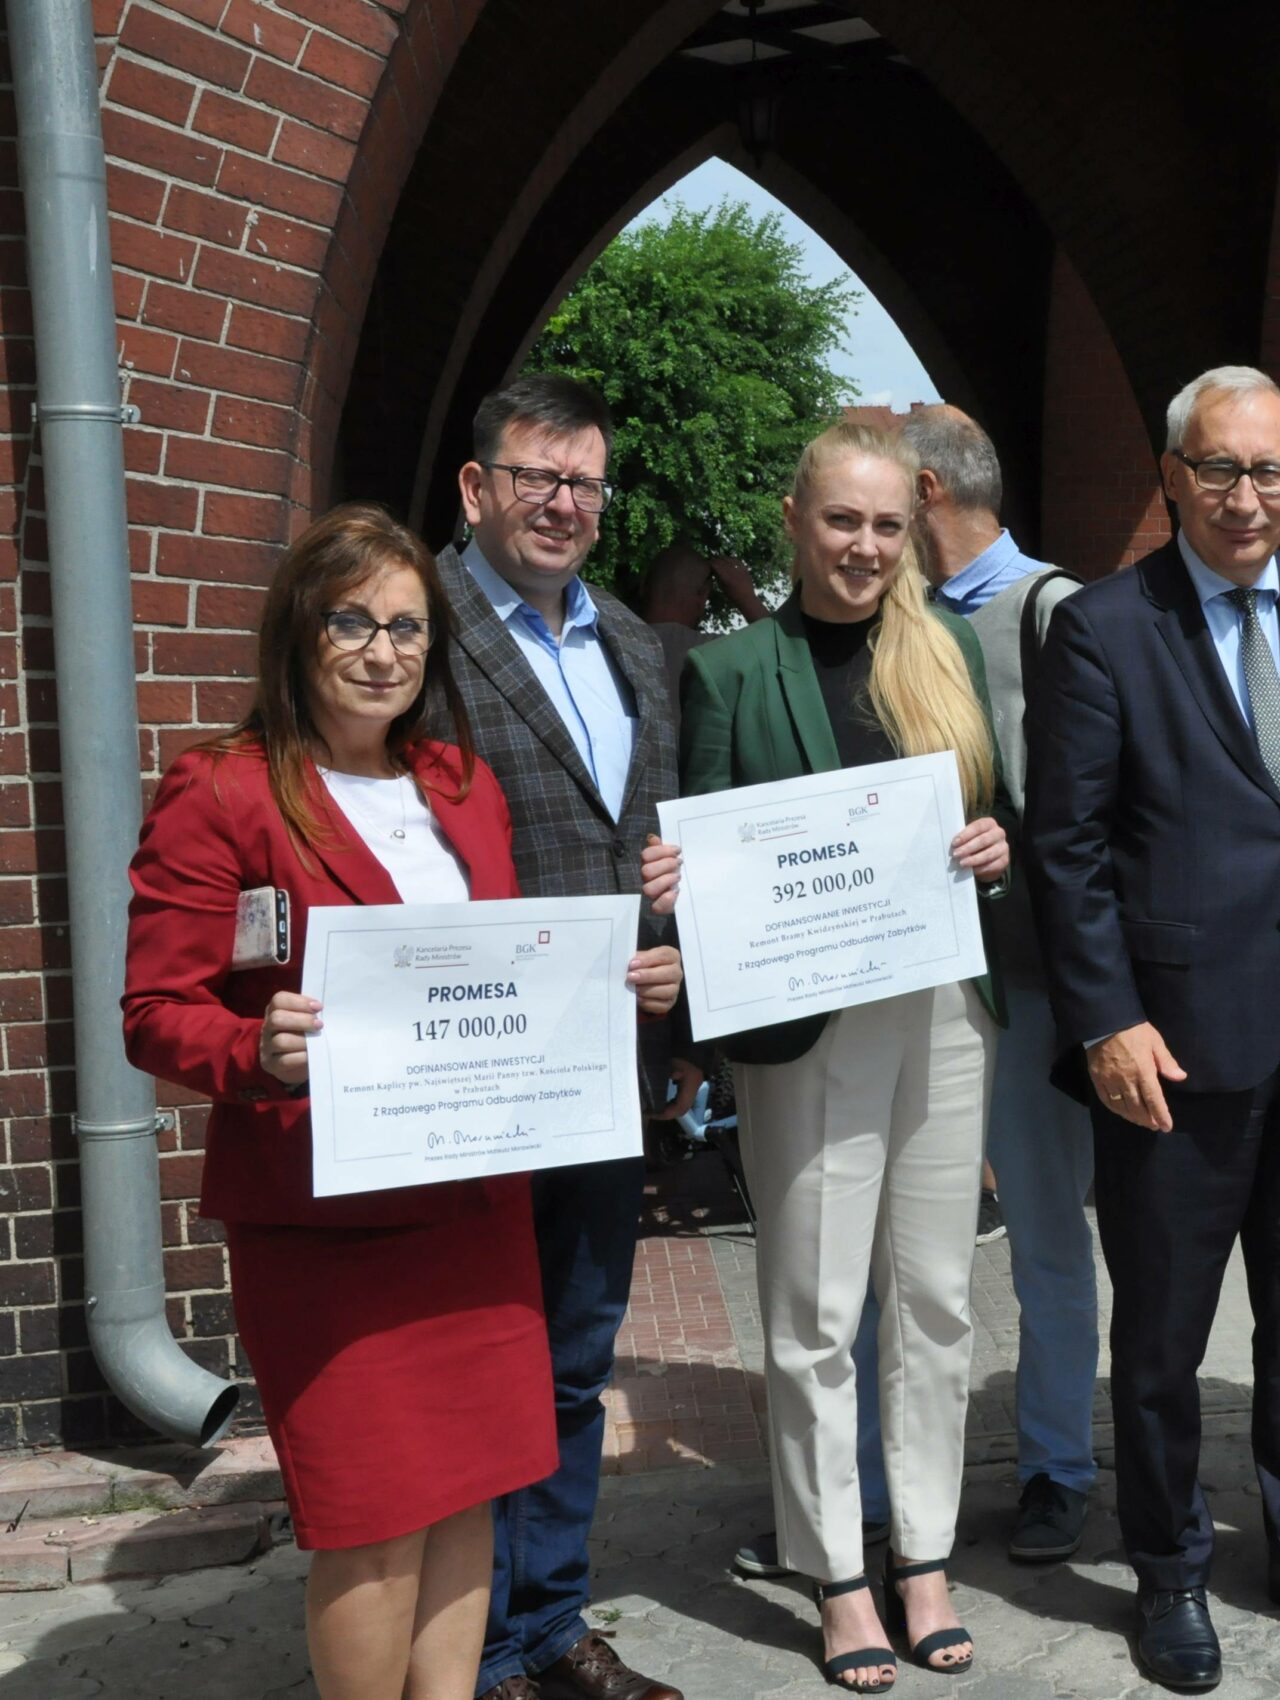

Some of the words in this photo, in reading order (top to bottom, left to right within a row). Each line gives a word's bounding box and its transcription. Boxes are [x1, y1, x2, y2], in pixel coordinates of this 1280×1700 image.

[848, 806, 868, 816] BGK
[777, 841, 859, 868] PROMESA
[772, 881, 807, 904] 392
[812, 867, 874, 895] 000,00
[765, 909, 839, 932] DOFINANSOWANIE
[842, 899, 891, 915] INWESTYCJI
[515, 944, 537, 954] BGK
[745, 952, 795, 969] Rządowego
[796, 943, 838, 957] Programu
[839, 933, 885, 949] Odbudowy
[887, 924, 927, 938] Zabytków
[749, 937, 779, 948] Remont
[781, 932, 805, 942] Bramy
[428, 982, 518, 1003] PROMESA
[412, 1018, 451, 1042] 147
[458, 1013, 527, 1040] 000,00
[406, 1059, 489, 1075] DOFINANSOWANIE
[491, 1055, 545, 1068] INWESTYCJI
[343, 1084, 375, 1093] Remont
[377, 1081, 406, 1092] Kaplicy
[497, 1070, 519, 1080] Panny
[462, 1083, 500, 1094] Prabutach
[373, 1107, 379, 1117] Z
[381, 1103, 436, 1117] Rządowego
[438, 1099, 484, 1112] Programu
[485, 1092, 537, 1105] Odbudowy
[538, 1088, 582, 1100] Zabytków
